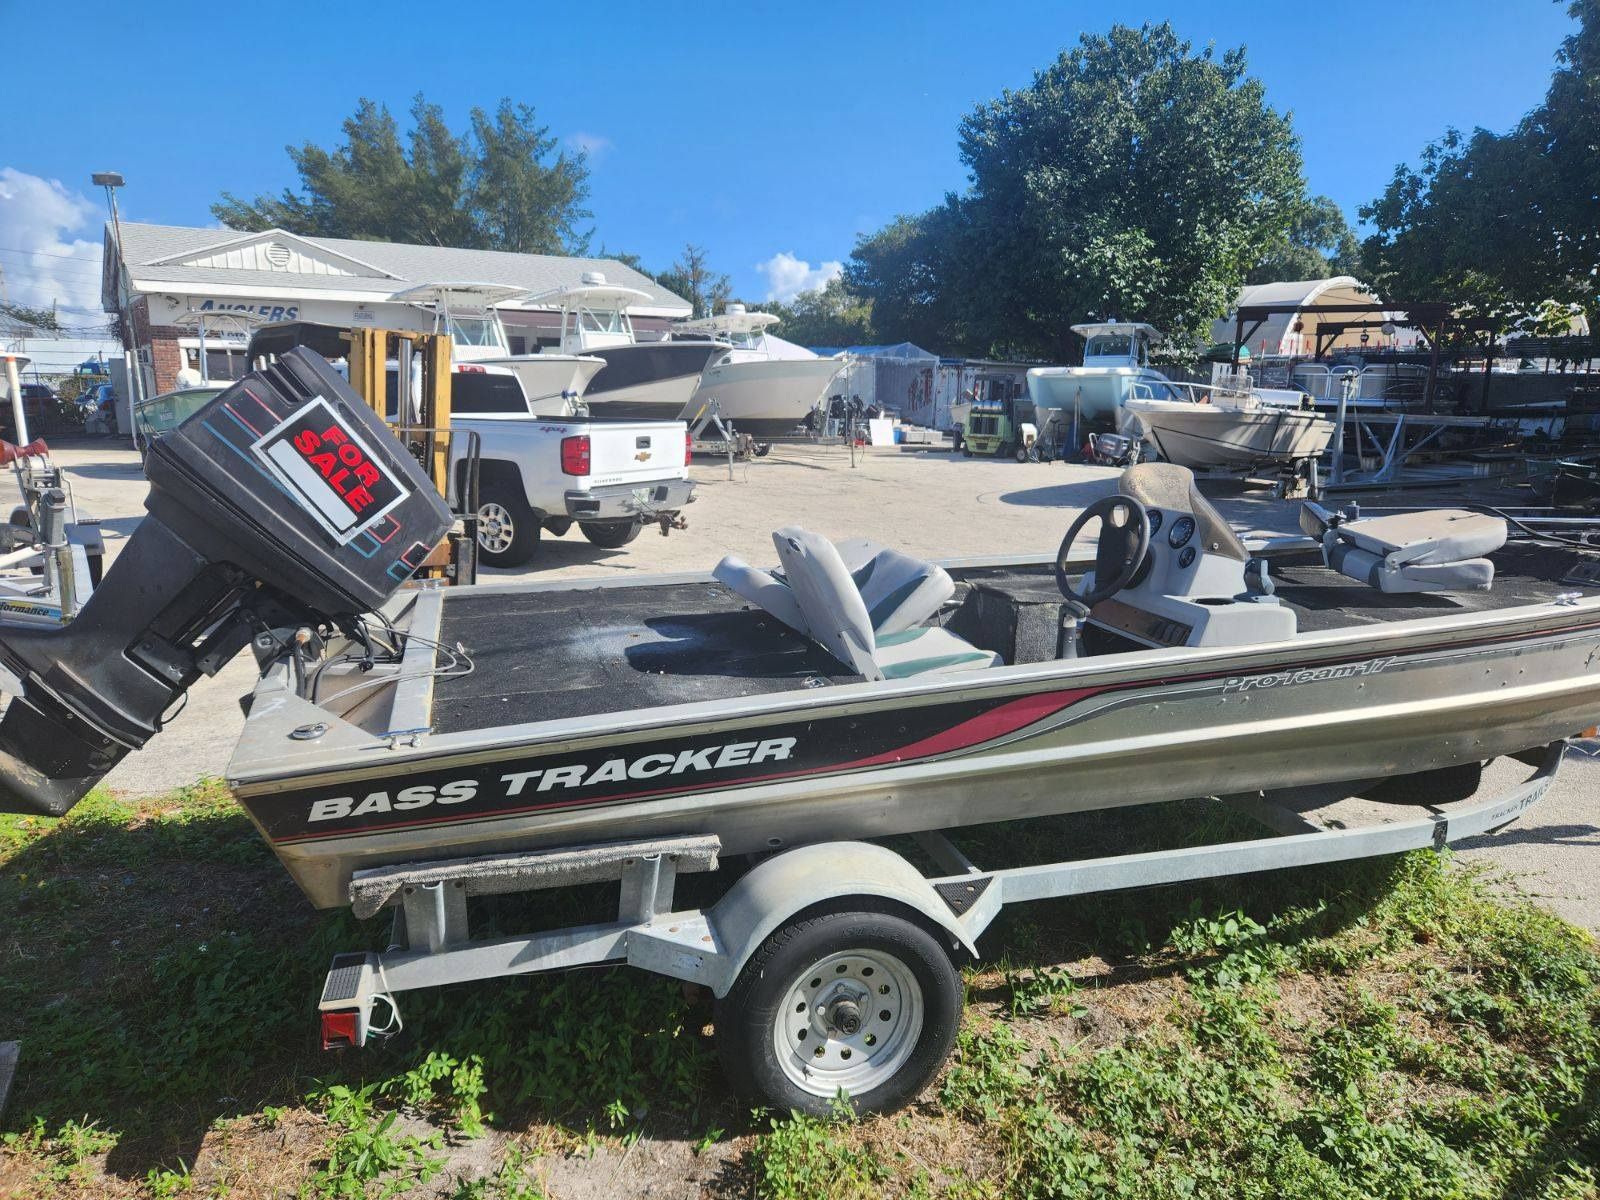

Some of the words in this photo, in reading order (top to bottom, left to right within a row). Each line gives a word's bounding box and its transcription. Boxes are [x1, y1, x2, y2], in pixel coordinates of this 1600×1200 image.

[293, 429, 375, 513] SALE
[320, 424, 380, 488] FOR
[307, 779, 480, 823] BASS
[500, 736, 797, 797] TRACKER
